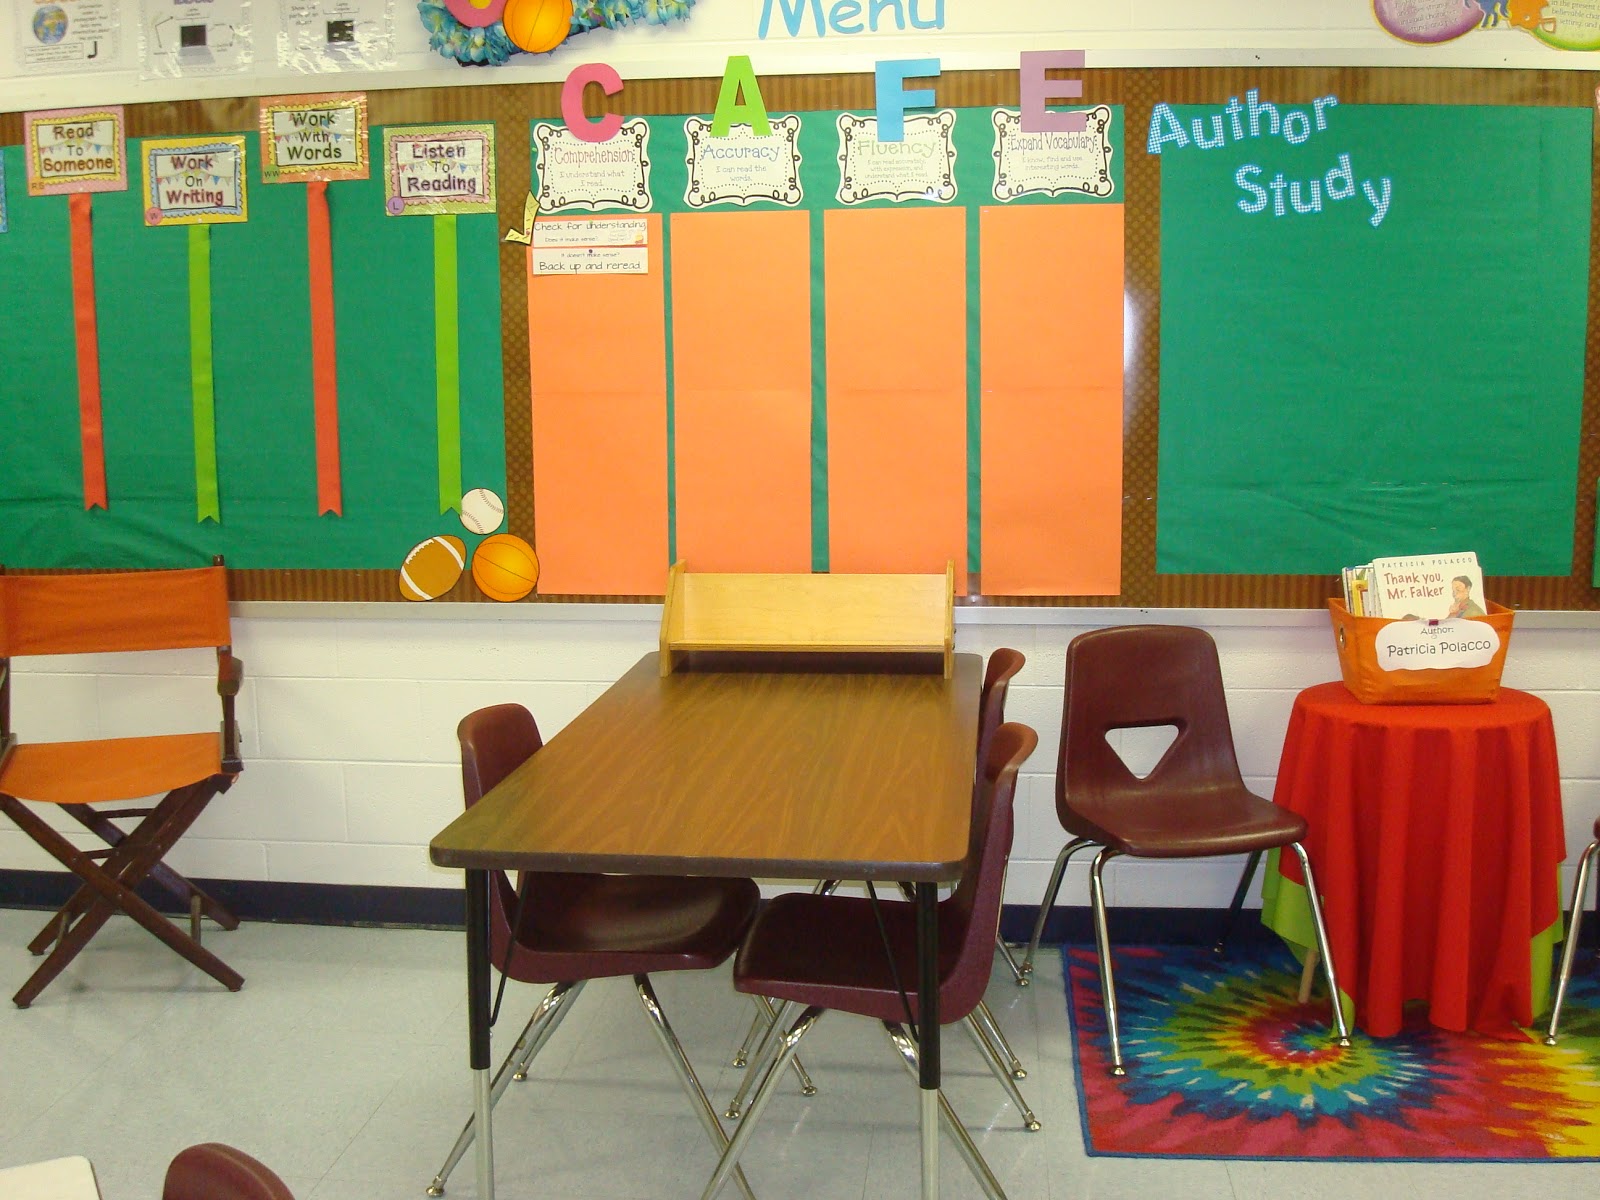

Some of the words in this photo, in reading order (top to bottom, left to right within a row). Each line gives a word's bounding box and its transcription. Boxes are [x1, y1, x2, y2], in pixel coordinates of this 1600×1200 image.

[757, 0, 945, 40] Menu
[291, 111, 336, 128] Work
[1147, 87, 1339, 154] Author
[53, 121, 95, 141] Read
[299, 130, 330, 143] With
[67, 144, 84, 156] To
[288, 142, 342, 160] Words
[412, 144, 466, 159] Listen
[857, 140, 937, 159] Fluency
[1010, 132, 1043, 156] Expand
[1044, 132, 1095, 154] Vocabulary
[554, 146, 634, 168] Comprehension
[701, 144, 780, 162] Accuracy
[43, 156, 114, 173] Someone
[171, 155, 214, 170] Work
[432, 160, 450, 174] To
[716, 165, 721, 173] I
[736, 164, 753, 173] read
[754, 164, 767, 172] the
[185, 175, 203, 187] On
[607, 169, 625, 178] what
[407, 174, 477, 194] Reading
[1235, 152, 1392, 227] Study
[166, 189, 224, 206] Writing
[393, 201, 400, 211] L
[534, 222, 562, 231] Check
[566, 222, 582, 230] for
[586, 220, 646, 231] understanding
[539, 261, 565, 270] Back
[569, 263, 581, 274] up
[585, 261, 603, 270] and
[1381, 560, 1425, 569] PATRICIA
[1432, 557, 1473, 566] POLACCO
[1384, 572, 1419, 585] Thank
[1422, 573, 1444, 585] you,
[1387, 588, 1407, 600] Mr.
[1410, 586, 1444, 598] Falker
[1387, 643, 1436, 658] Patricia
[1439, 640, 1491, 655] Polacco
